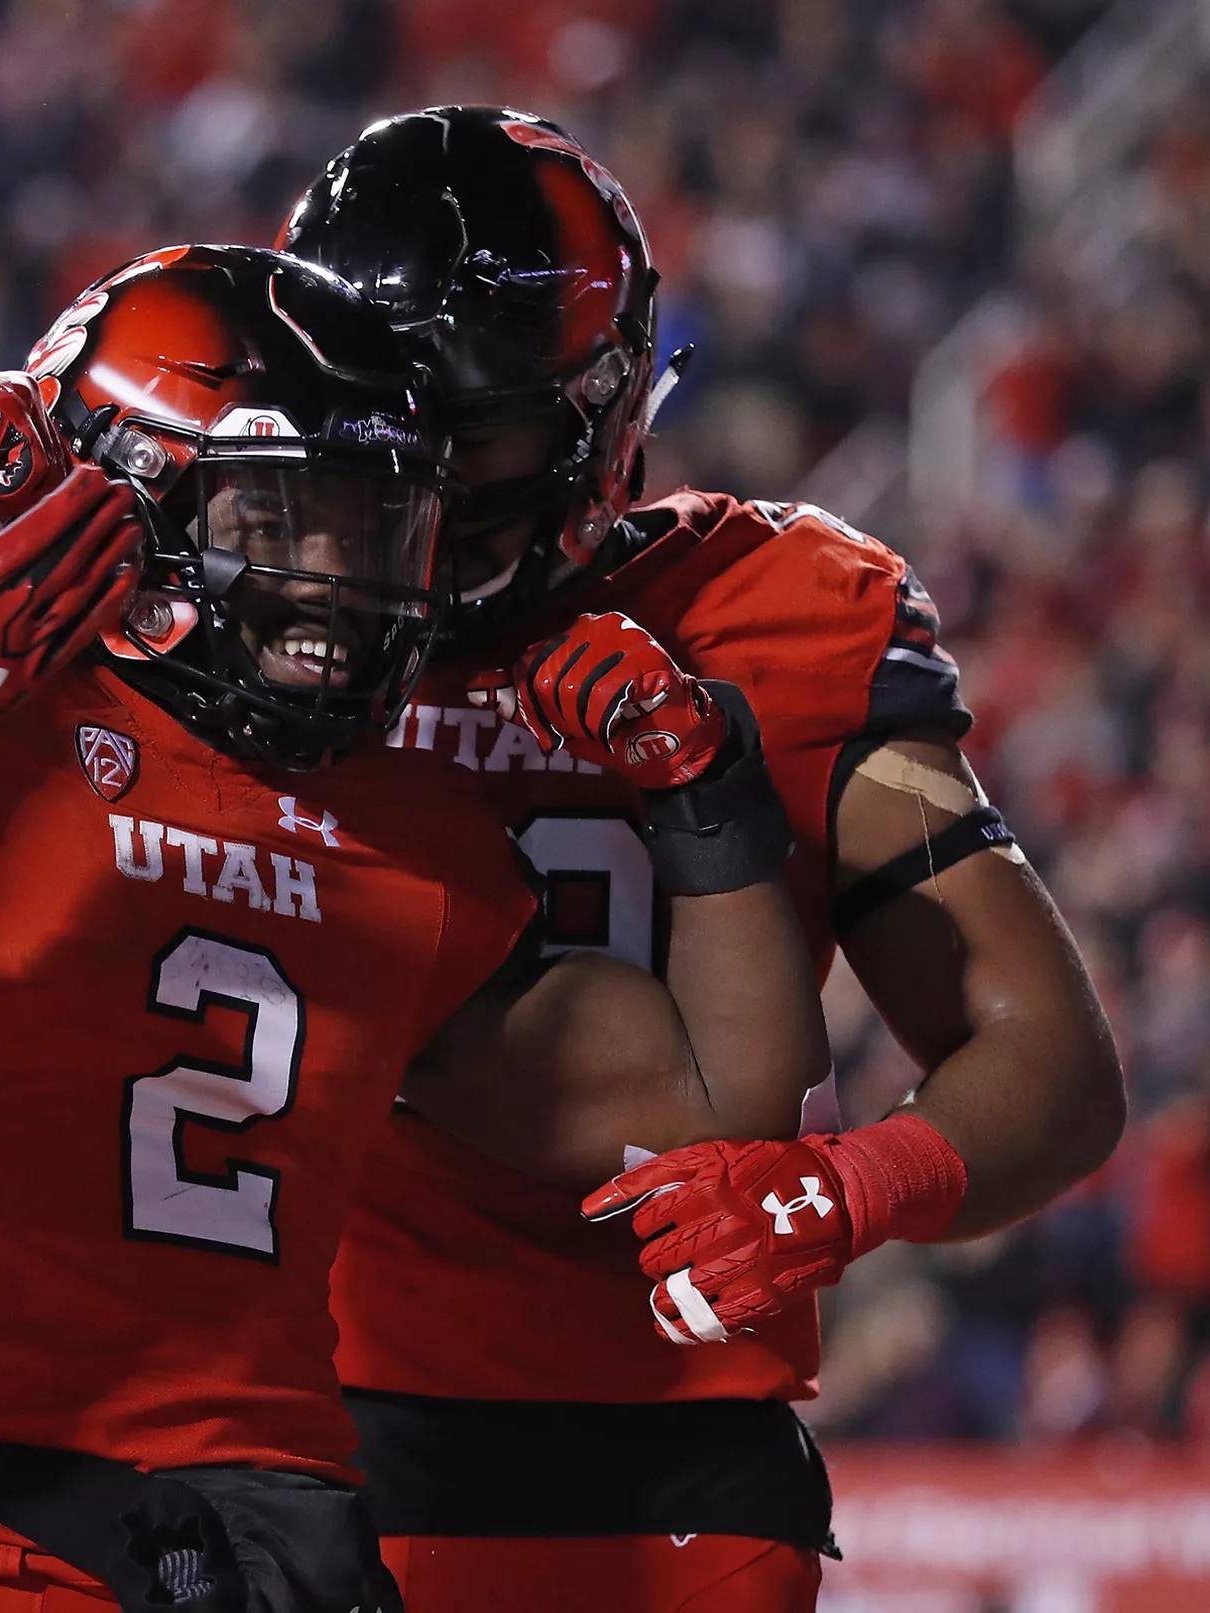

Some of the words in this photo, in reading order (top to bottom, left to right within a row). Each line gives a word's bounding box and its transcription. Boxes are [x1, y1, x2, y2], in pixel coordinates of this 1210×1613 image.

[79, 726, 136, 777] PAC
[93, 756, 123, 788] 12
[108, 813, 322, 924] UTAH
[119, 924, 305, 1267] 2
